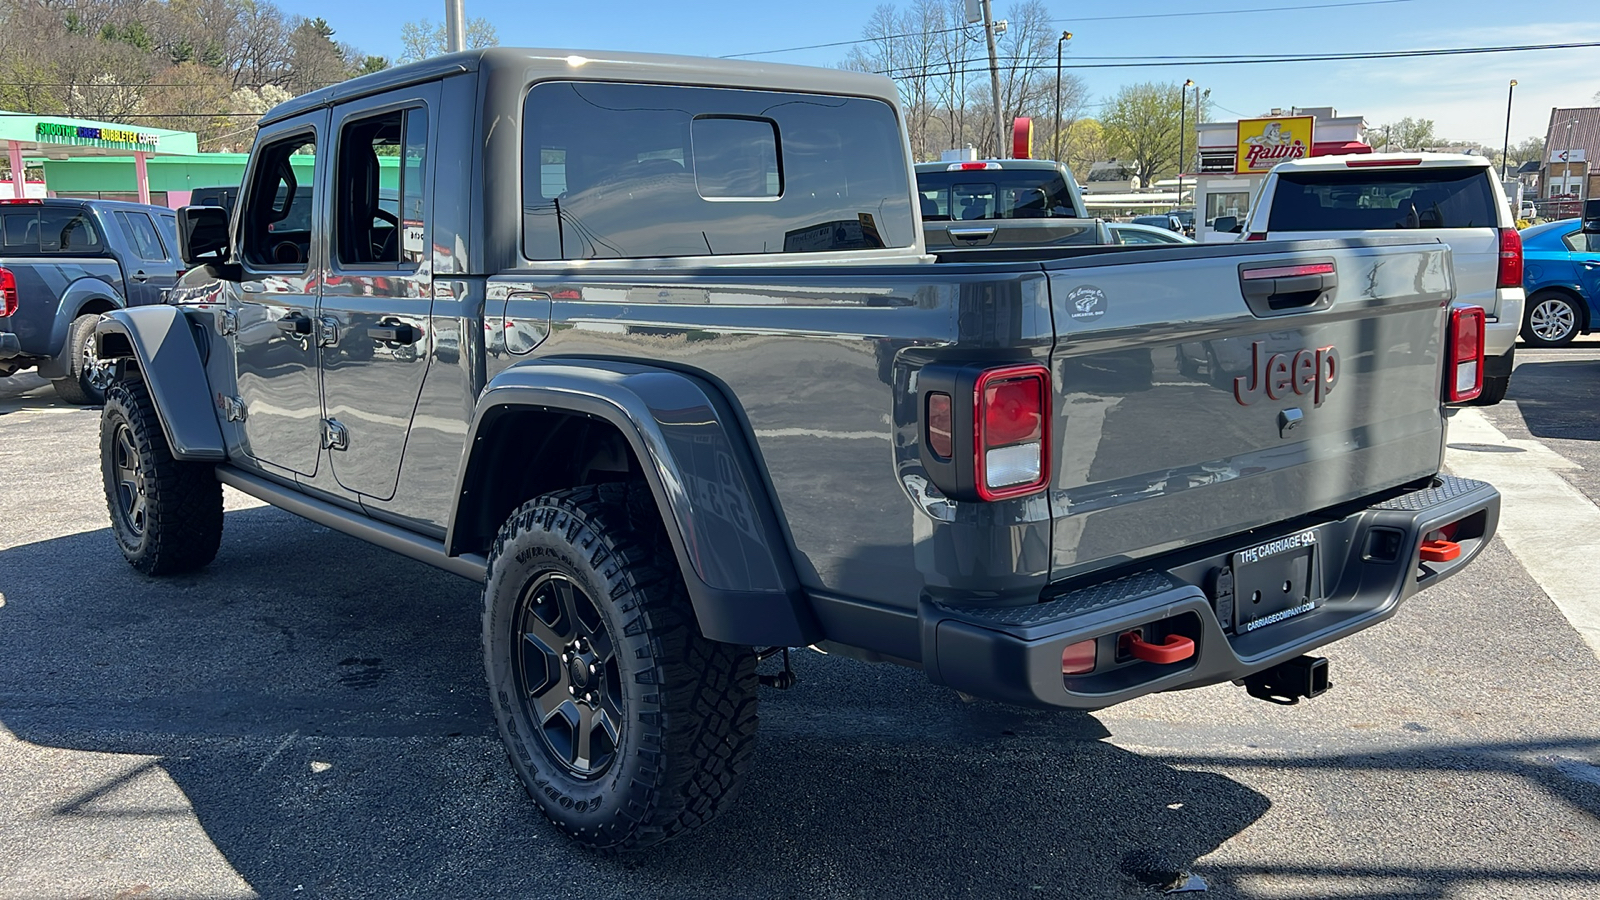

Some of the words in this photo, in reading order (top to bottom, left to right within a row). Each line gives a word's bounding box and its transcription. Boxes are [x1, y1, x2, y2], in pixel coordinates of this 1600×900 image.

[37, 122, 77, 138] SMOOTHIE
[100, 128, 139, 143] BUBBLETEA
[138, 132, 159, 145] COFFEE
[1245, 140, 1306, 169] Rally's
[1234, 341, 1341, 408] Jeep
[1240, 549, 1258, 563] THE
[1258, 535, 1301, 558] CARRIAGE
[1301, 531, 1316, 546] CO.
[1247, 602, 1315, 631] CARRIAGECOMPANY.COM
